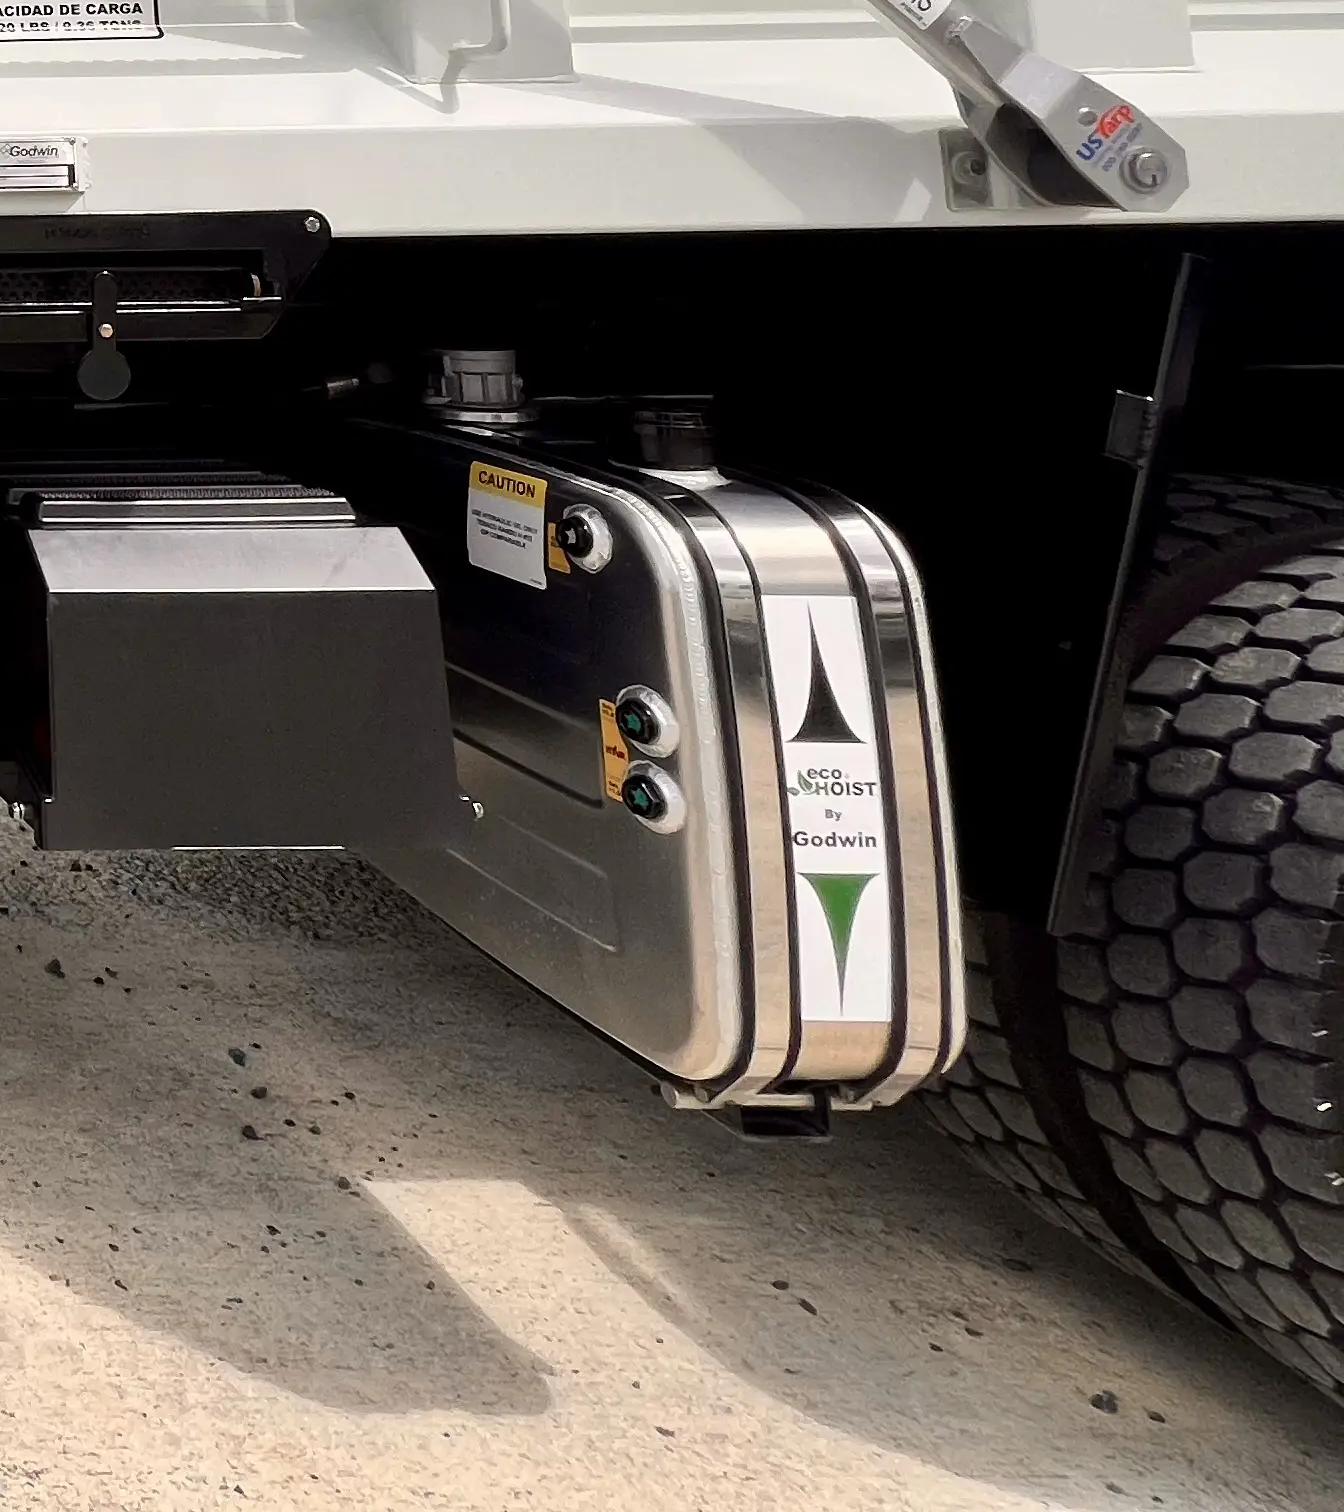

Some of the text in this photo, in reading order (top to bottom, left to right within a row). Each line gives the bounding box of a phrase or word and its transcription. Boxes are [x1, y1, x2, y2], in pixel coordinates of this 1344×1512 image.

[59, 3, 81, 15] DE
[85, 2, 144, 16] CARGA
[20, 21, 51, 32] LBS
[10, 144, 59, 157] Godwin
[478, 470, 536, 499] CAUTION
[807, 768, 842, 779] eco
[814, 781, 877, 796] HOIST
[824, 808, 843, 822] By
[793, 830, 878, 849] Godwin
